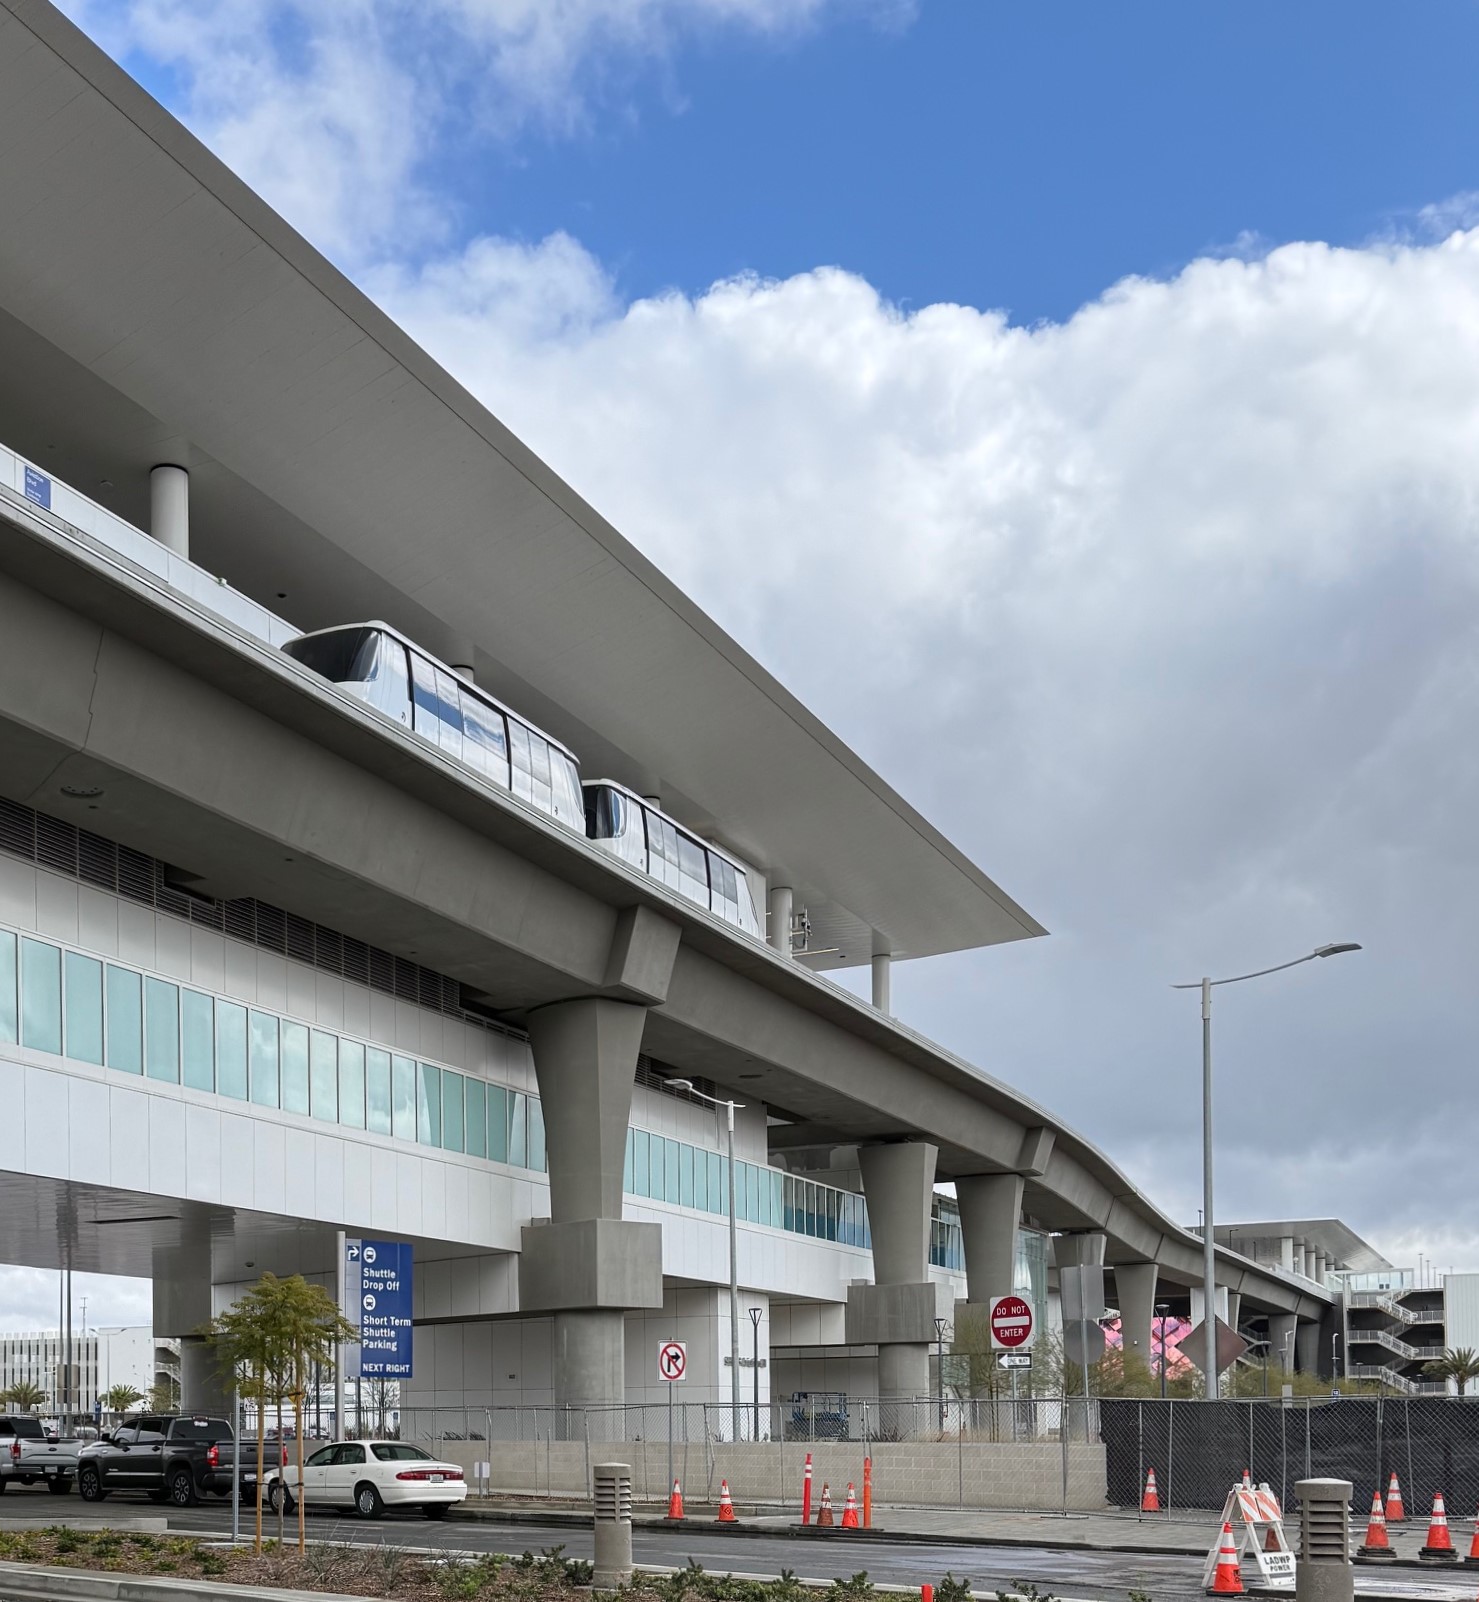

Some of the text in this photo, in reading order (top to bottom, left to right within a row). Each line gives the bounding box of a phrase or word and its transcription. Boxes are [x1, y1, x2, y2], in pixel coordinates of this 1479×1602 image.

[363, 1267, 396, 1279] Shuttle
[363, 1279, 400, 1292] Drop Off
[996, 1305, 1026, 1316] DO NOT
[363, 1315, 412, 1327] Short Term
[363, 1327, 396, 1338] Shuttle
[1000, 1328, 1024, 1338] ENTER
[363, 1339, 398, 1352] Parking
[1007, 1357, 1017, 1365] ONE
[362, 1363, 410, 1374] NEXT RIGHT
[1264, 1555, 1291, 1565] LADWP
[1269, 1564, 1291, 1572] POWER
